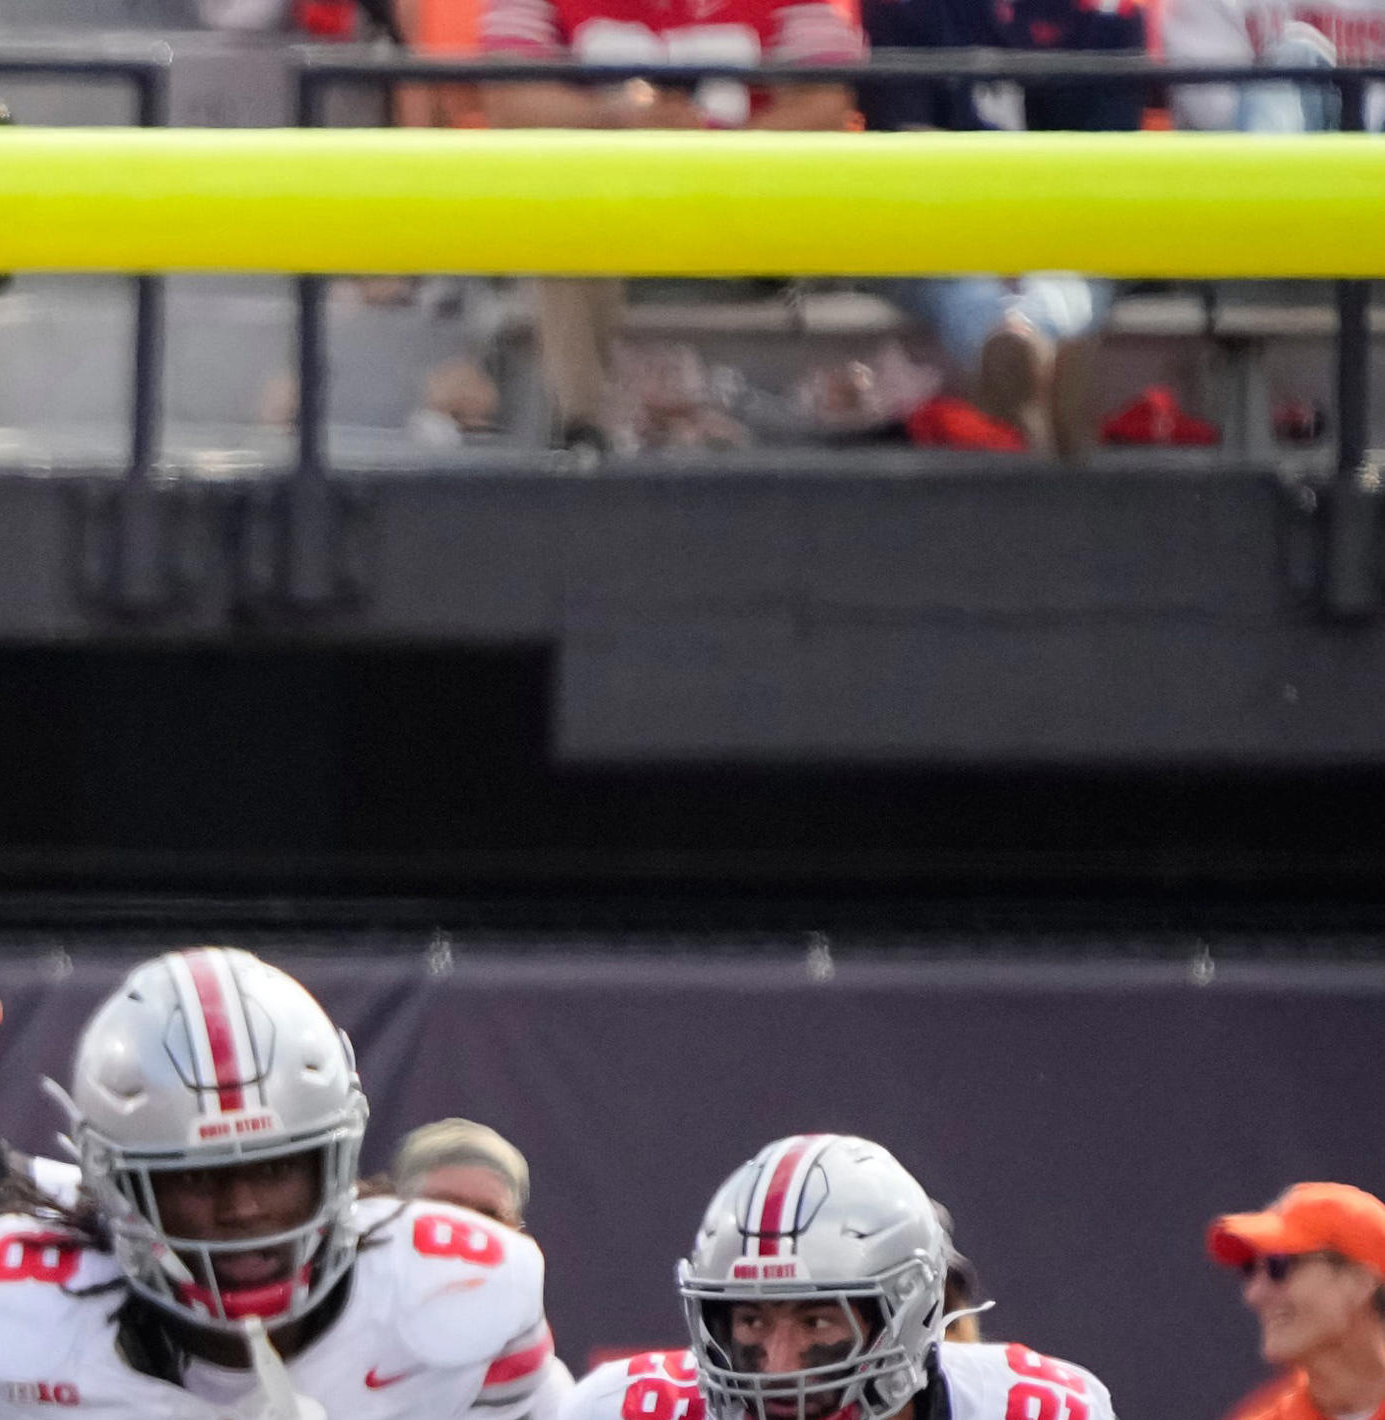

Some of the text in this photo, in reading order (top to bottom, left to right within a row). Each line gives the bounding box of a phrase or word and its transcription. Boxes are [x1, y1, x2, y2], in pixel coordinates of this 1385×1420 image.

[200, 1115, 273, 1139] OHIO STATE
[413, 1214, 505, 1267] 8
[733, 1263, 797, 1280] OHIO STATE
